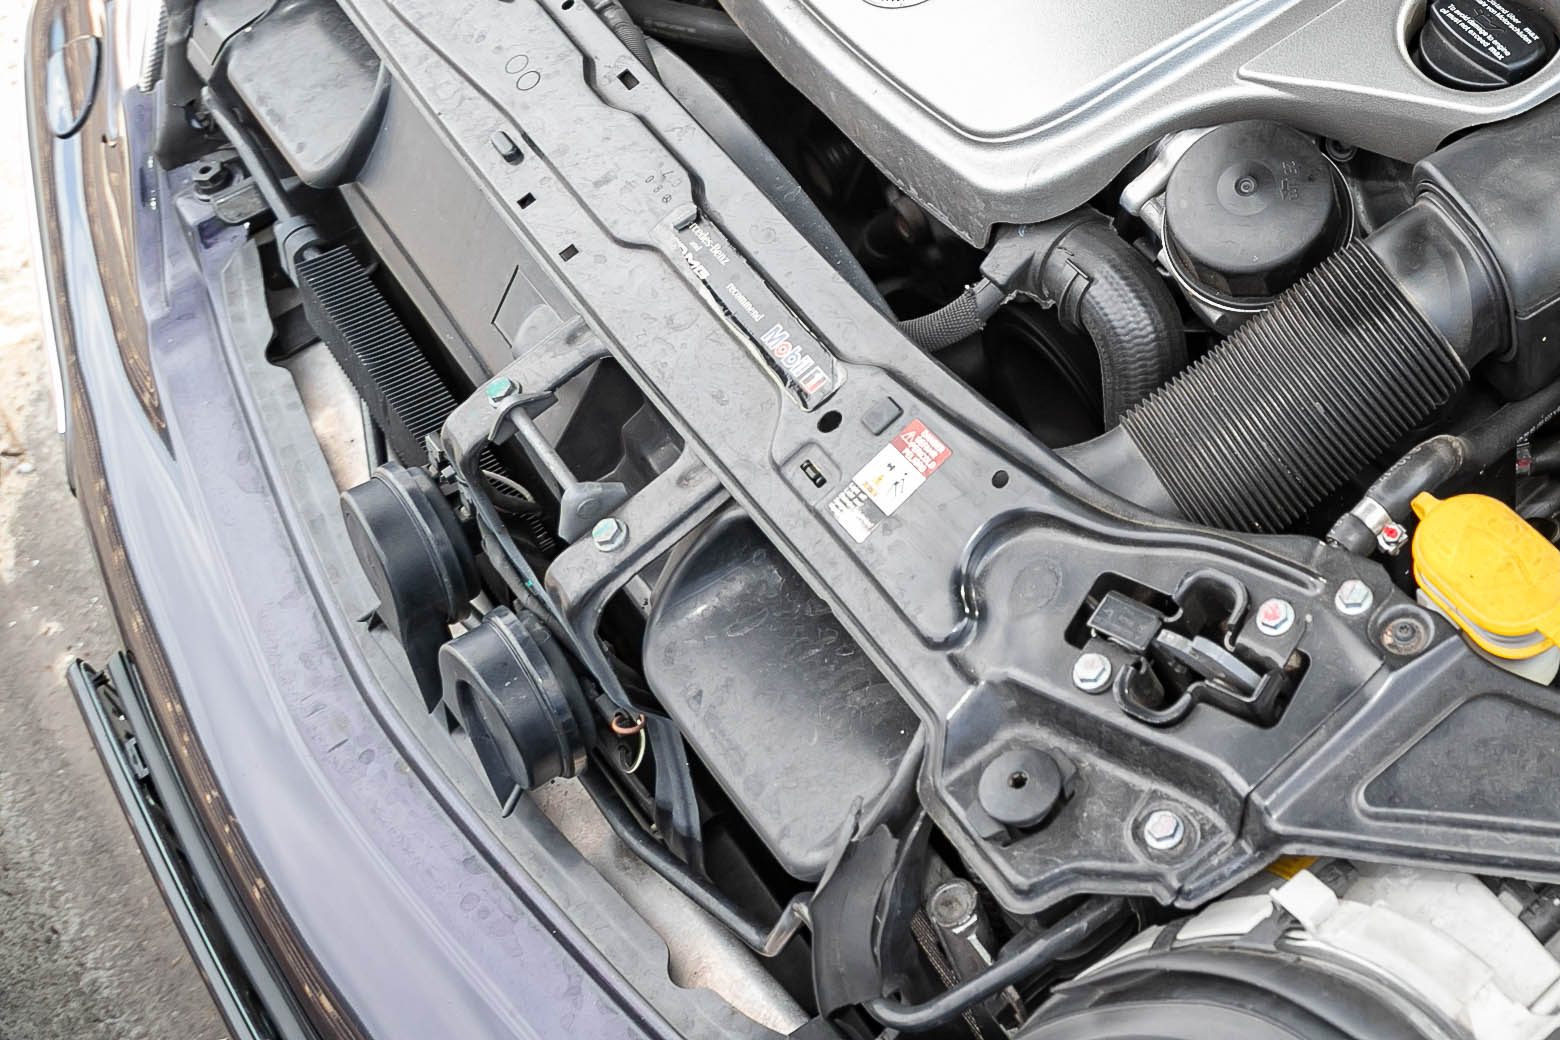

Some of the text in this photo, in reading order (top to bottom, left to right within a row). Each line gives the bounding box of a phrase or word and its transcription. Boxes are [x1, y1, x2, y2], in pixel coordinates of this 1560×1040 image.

[1446, 13, 1460, 24] must
[1459, 22, 1469, 31] not
[1468, 30, 1489, 47] exceed
[1488, 46, 1504, 60] max
[1454, 9, 1469, 20] avoid
[1467, 18, 1488, 37] damage
[1491, 39, 1510, 56] engine
[1523, 27, 1539, 40] max
[690, 222, 732, 266] rcedes-Benz
[726, 282, 765, 322] recommend
[760, 324, 814, 377] Mobil
